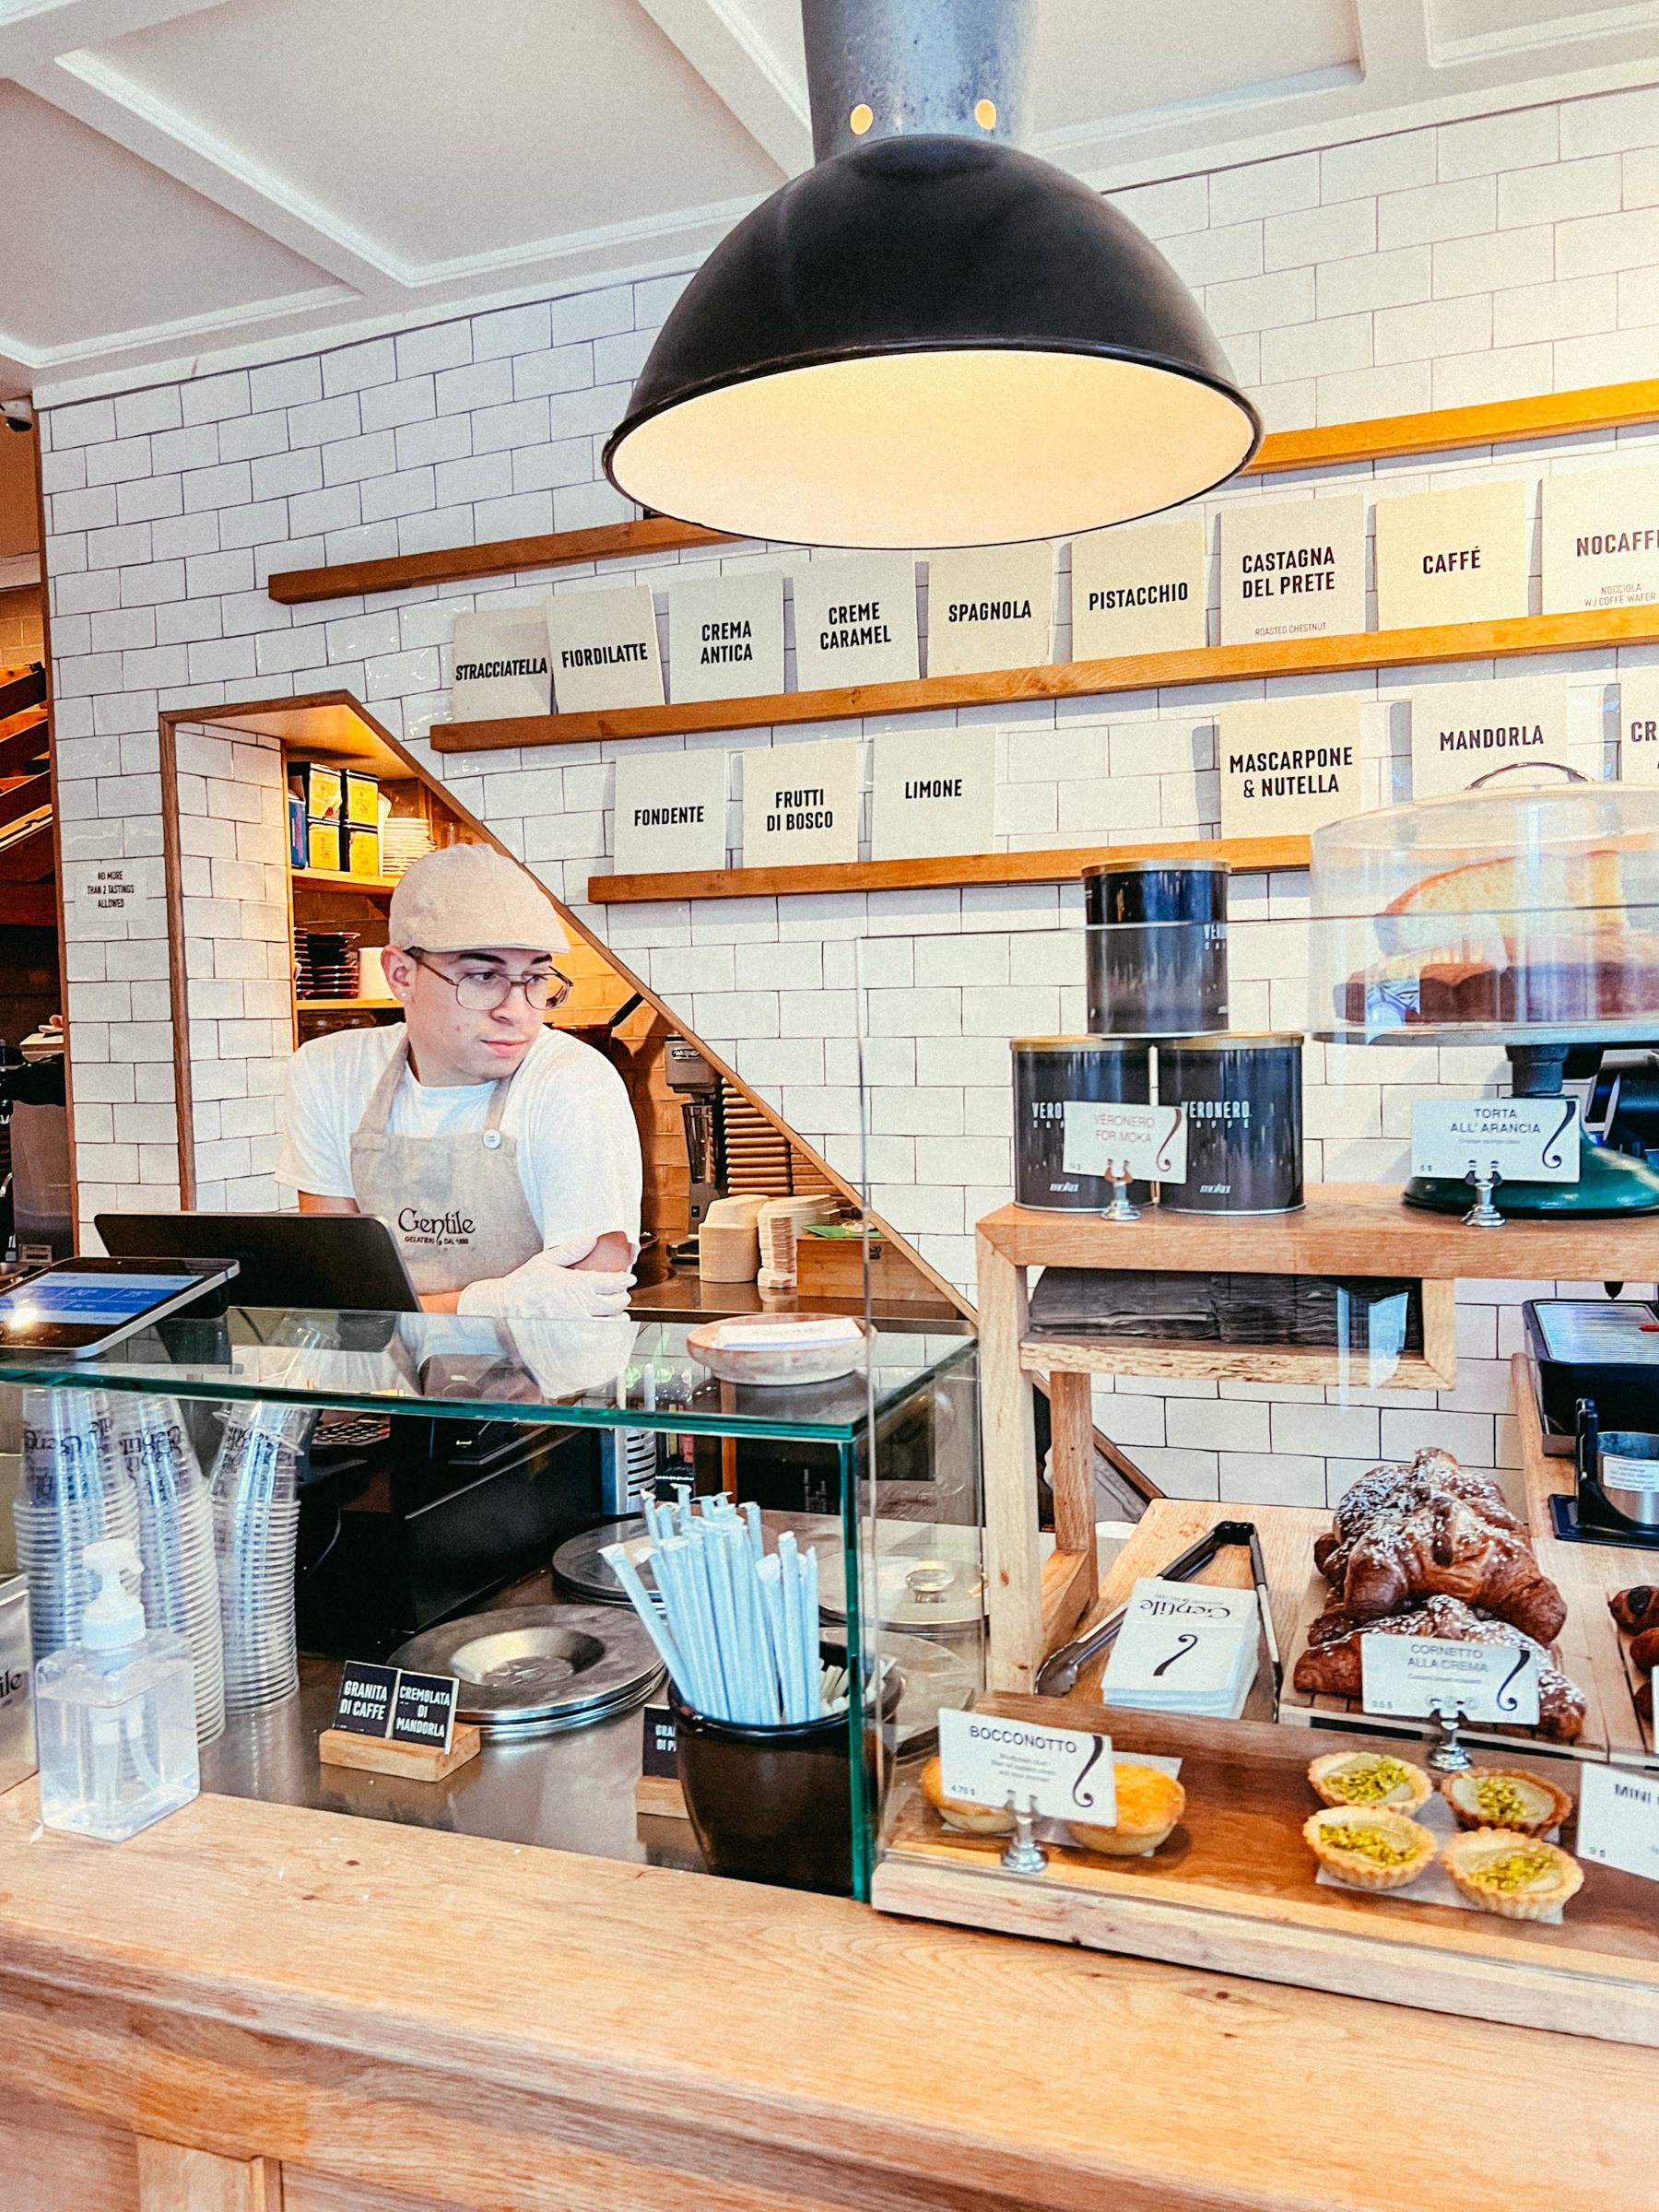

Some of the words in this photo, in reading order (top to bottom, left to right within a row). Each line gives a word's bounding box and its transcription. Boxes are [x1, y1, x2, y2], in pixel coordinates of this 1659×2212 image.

[1241, 546, 1335, 574] CASTAGNA
[1422, 546, 1482, 575] CAFFÉ
[1242, 578, 1275, 599] DEL
[1280, 571, 1335, 595] PRETE
[1601, 582, 1642, 595] NOCCIOLA
[1088, 582, 1189, 611] PISTACCHIO
[1627, 592, 1656, 604] WAFER
[828, 601, 881, 627] CREME
[947, 599, 1032, 623] SPAGNOLA
[700, 620, 753, 642] CREMA
[818, 623, 892, 652] CARAMEL
[1254, 626, 1288, 637] ROASTED
[1289, 621, 1327, 633] CHESTNUT
[560, 641, 648, 669] FIORDILATTE
[700, 642, 754, 665] ANTICA
[454, 656, 549, 682] STRACCIATELLA
[1439, 724, 1545, 752] MANDORLA
[1229, 746, 1354, 775] MASCARPONE
[904, 778, 963, 800] LIMONE
[1242, 778, 1256, 799] &
[1260, 772, 1340, 797] NUTELLA
[774, 788, 825, 809] FRUTTI
[633, 805, 705, 828] FONDENTE
[766, 813, 781, 832] DI
[785, 810, 834, 831] BOSCO
[97, 871, 106, 880] NO
[107, 870, 123, 880] MORE
[102, 885, 107, 895] 2
[108, 884, 135, 894] TASTINGS
[98, 898, 124, 909] ALLOWED
[1094, 1113, 1155, 1128] VERONERO
[1474, 1108, 1517, 1119] TORTA
[1095, 1129, 1116, 1141] FOR
[1120, 1131, 1151, 1144] MOKA
[398, 1207, 476, 1245] Gentile
[1411, 1643, 1483, 1659] CORNETTO
[1407, 1658, 1438, 1668] ALLA
[1441, 1659, 1488, 1673] CREMA
[343, 1680, 387, 1702] GRANITA
[399, 1685, 451, 1706] CREMOLATA
[338, 1698, 352, 1716] DI
[352, 1700, 386, 1721] CAFFE
[417, 1704, 429, 1719] DI
[395, 1716, 445, 1738] MANDORLA
[970, 1725, 1077, 1754] BOCCONOTTO
[1615, 1783, 1651, 1805] MINI
